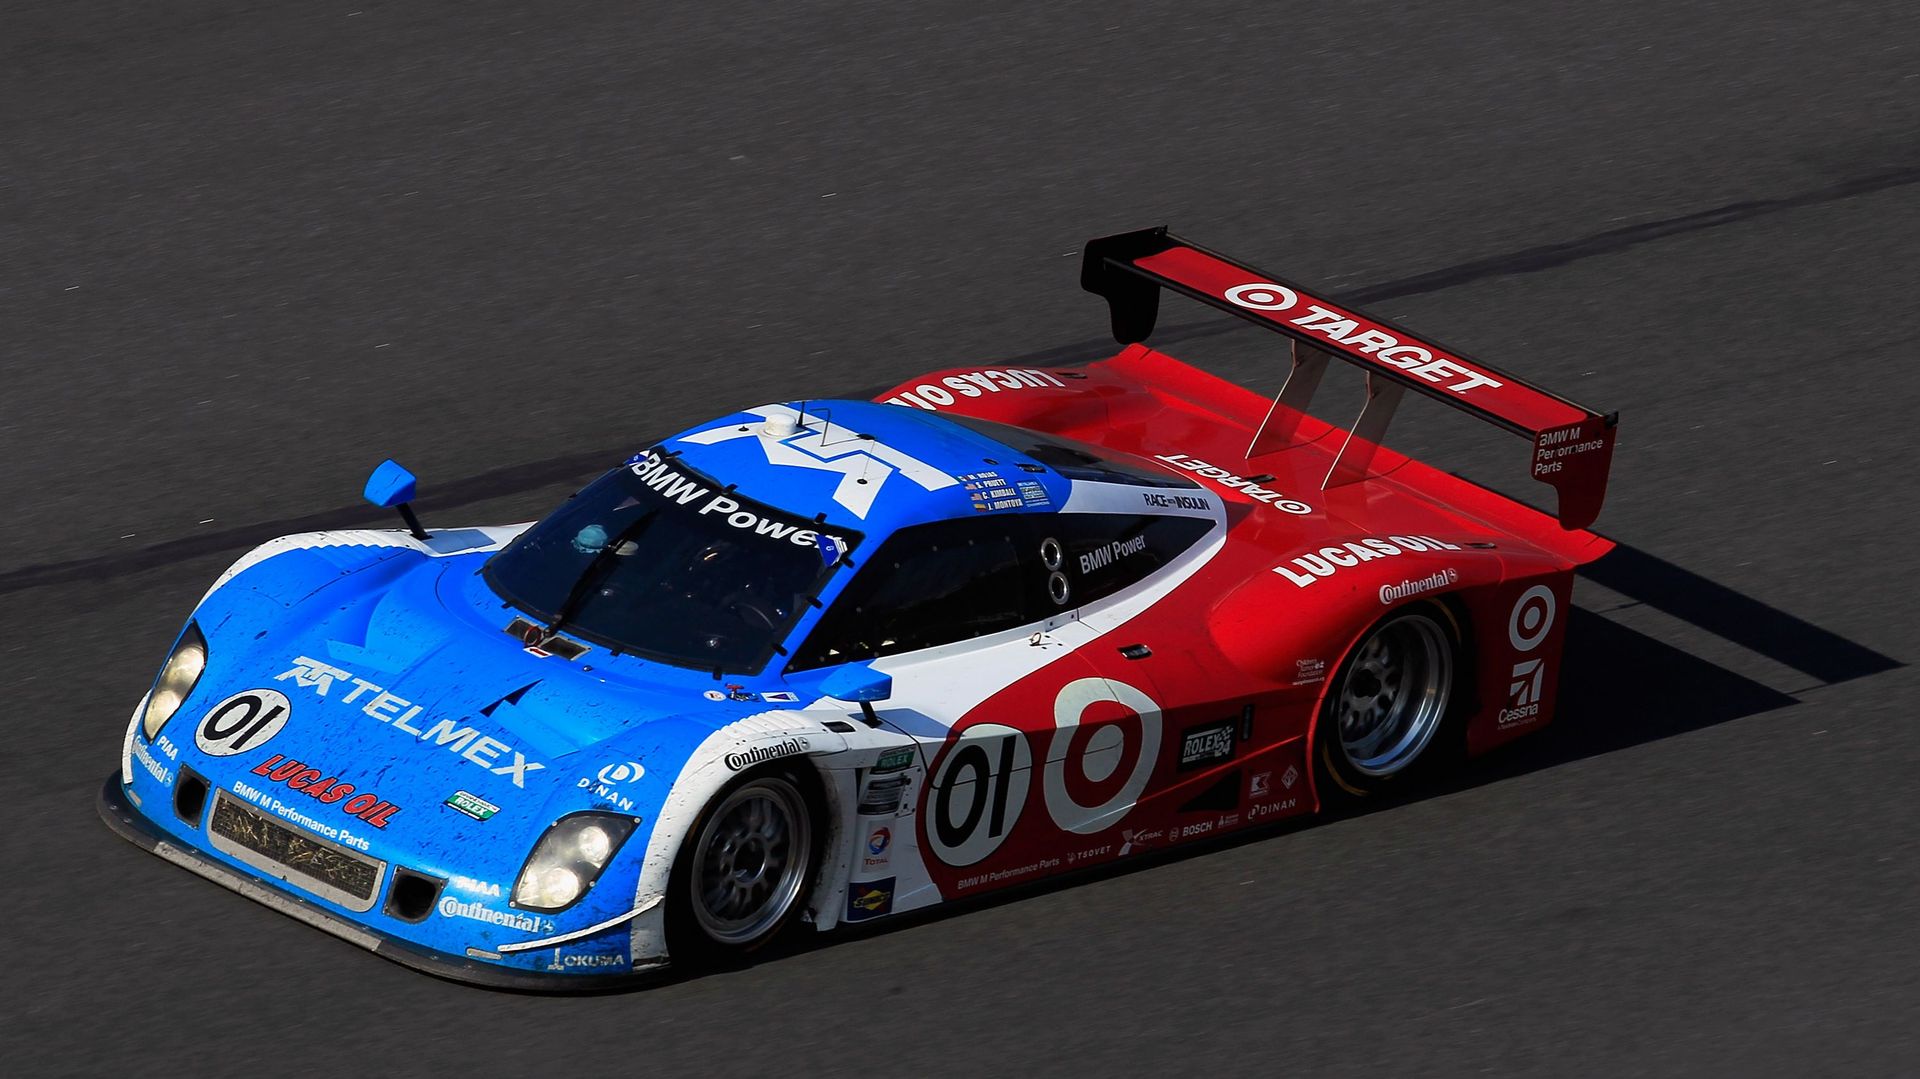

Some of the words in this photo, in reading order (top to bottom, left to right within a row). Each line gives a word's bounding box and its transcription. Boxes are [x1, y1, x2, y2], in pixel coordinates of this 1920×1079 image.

[942, 369, 1065, 397] LUCAS
[1539, 429, 1569, 447] BMW
[1570, 427, 1580, 440] M
[631, 453, 709, 505] BMW
[1154, 453, 1284, 504] TARGET
[1535, 462, 1563, 475] Parts
[1143, 493, 1169, 508] RACE
[1174, 496, 1211, 511] INSULIN
[1079, 545, 1112, 575] BMW
[1112, 534, 1147, 560] Power
[1271, 534, 1403, 588] LUCAS
[1388, 535, 1463, 552] OIL
[1379, 568, 1451, 605] Continental
[203, 695, 286, 750] 01
[1498, 704, 1539, 724] Cessna
[156, 735, 179, 761] PIAA
[341, 677, 546, 789] TELMEX
[1183, 734, 1219, 757] ROLEX
[1215, 739, 1232, 757] 24
[132, 735, 168, 784] Continental
[724, 738, 803, 771] Continental
[250, 754, 355, 804] LUCAS
[343, 793, 401, 830] OIL
[454, 797, 489, 816] ROLEX
[935, 735, 1017, 848] 01
[1259, 798, 1297, 816] DINAN
[233, 781, 260, 802] BMW
[259, 796, 273, 808] M
[270, 800, 338, 839] Performance
[338, 829, 371, 851] Parts
[1182, 820, 1213, 837] BOSCH
[1077, 845, 1112, 860] TSOVET
[957, 875, 980, 890] BMW
[980, 873, 988, 883] M
[989, 863, 1038, 882] Performance
[1039, 858, 1060, 871] Parts
[438, 896, 541, 934] Continental
[564, 954, 625, 967] OKUMA
